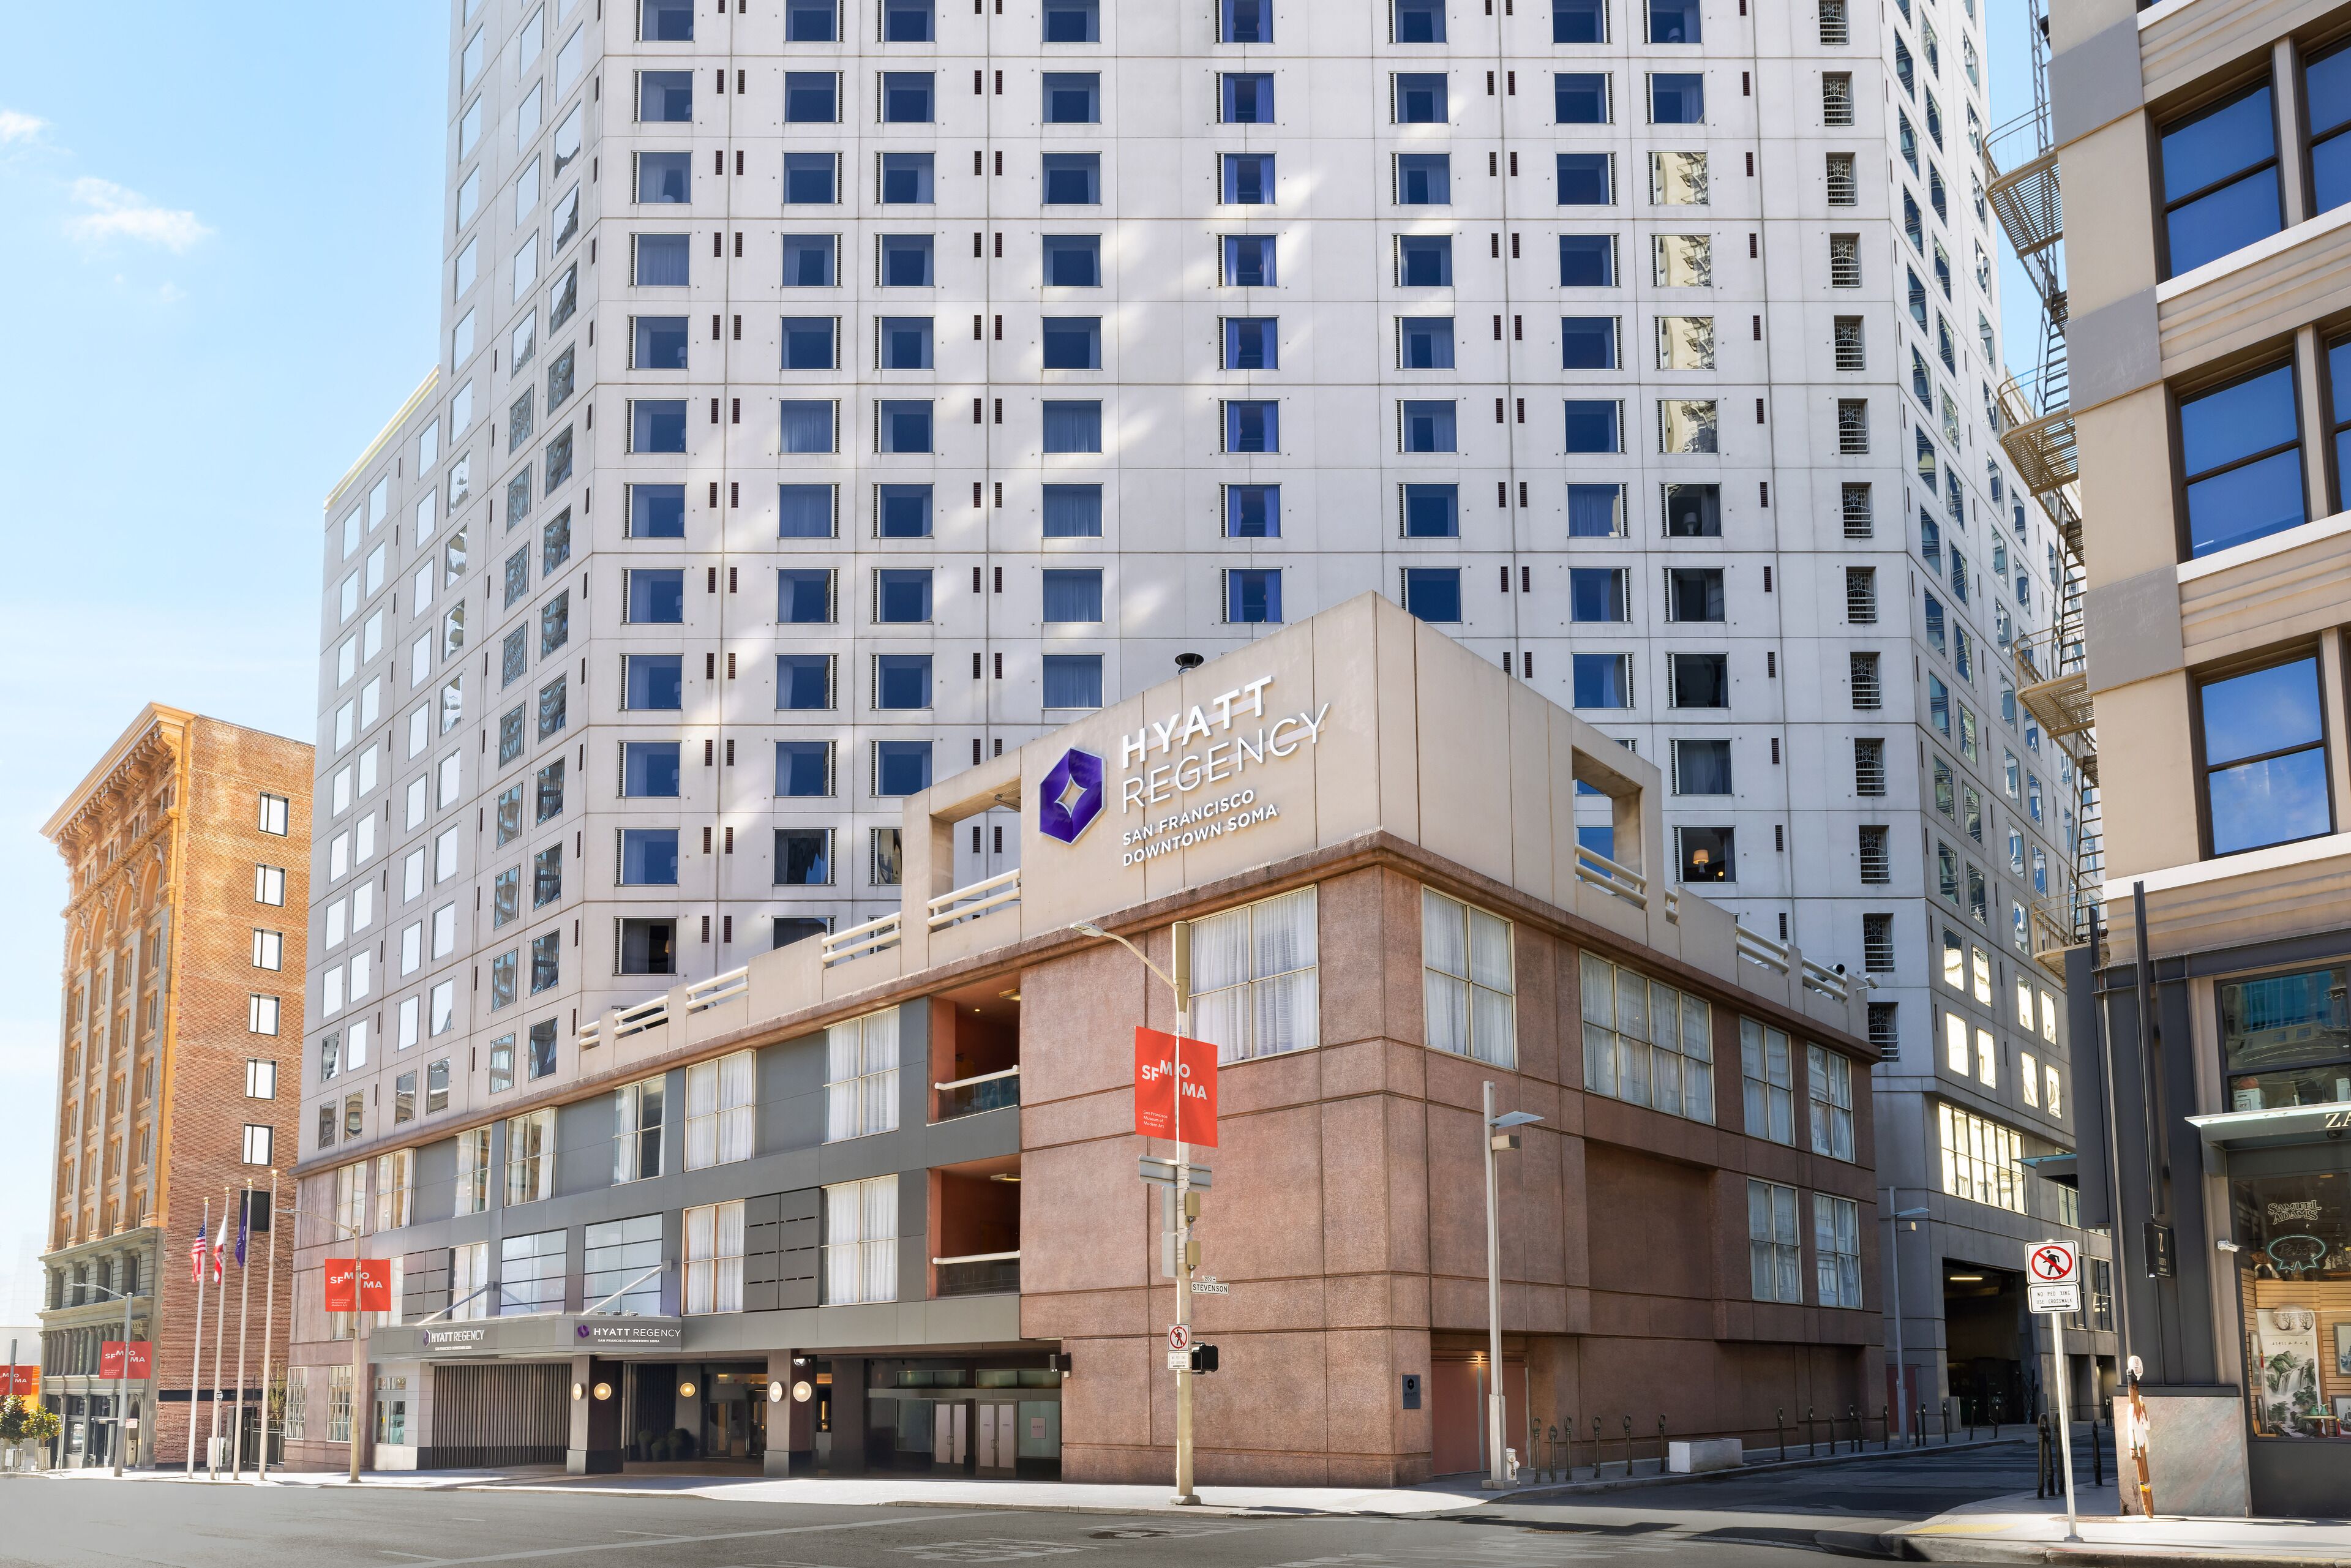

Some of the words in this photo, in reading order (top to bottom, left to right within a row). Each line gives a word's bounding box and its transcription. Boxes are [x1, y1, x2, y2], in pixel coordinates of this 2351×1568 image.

[1122, 675, 1273, 769] HYATT
[1123, 702, 1330, 814] REGENCY
[1123, 823, 1153, 846] SAN
[1159, 789, 1254, 835] FRANCISCO
[1123, 822, 1222, 867] DOWNTOWN
[1228, 803, 1278, 831] SOMA
[2268, 1199, 2322, 1215] SAMUEL
[2273, 1209, 2319, 1225] ADAMS
[2278, 1243, 2317, 1256] Pabst
[1193, 1283, 1228, 1292] STEVENSON
[431, 1332, 453, 1343] HYATT
[453, 1329, 485, 1341] REGENCY
[594, 1327, 630, 1337] HYATT
[633, 1329, 681, 1337] REGENCY
